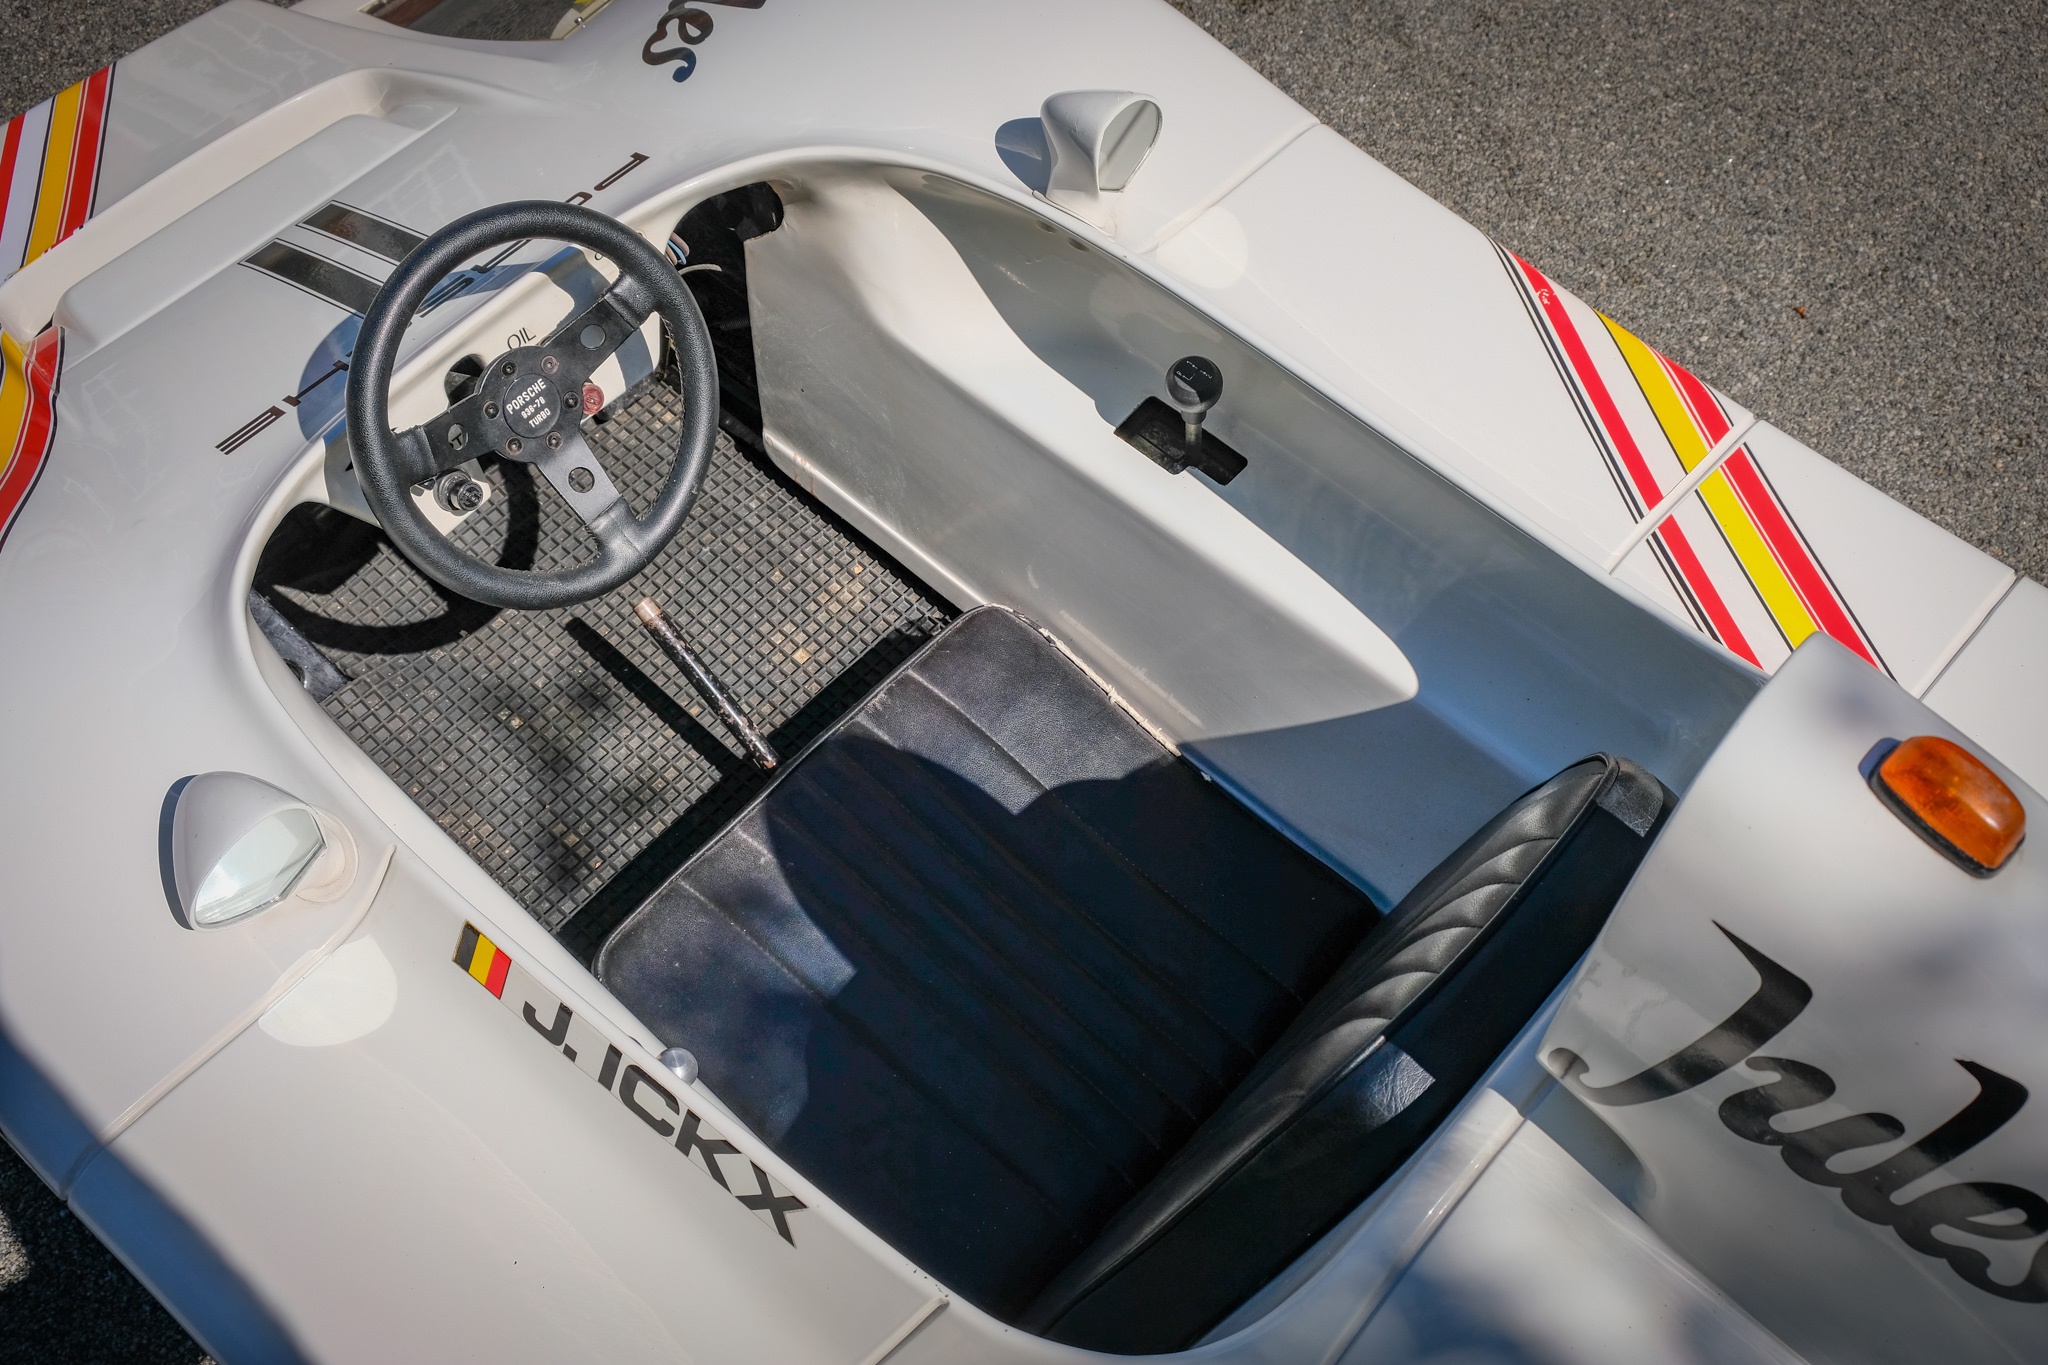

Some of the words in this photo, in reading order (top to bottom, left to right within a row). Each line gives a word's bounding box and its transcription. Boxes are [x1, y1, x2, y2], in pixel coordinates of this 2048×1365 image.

[507, 327, 536, 350] OIL
[506, 378, 547, 415] PORSCHE
[528, 408, 551, 428] TURBO
[522, 1000, 578, 1063] J.
[598, 1043, 809, 1249] ICKX
